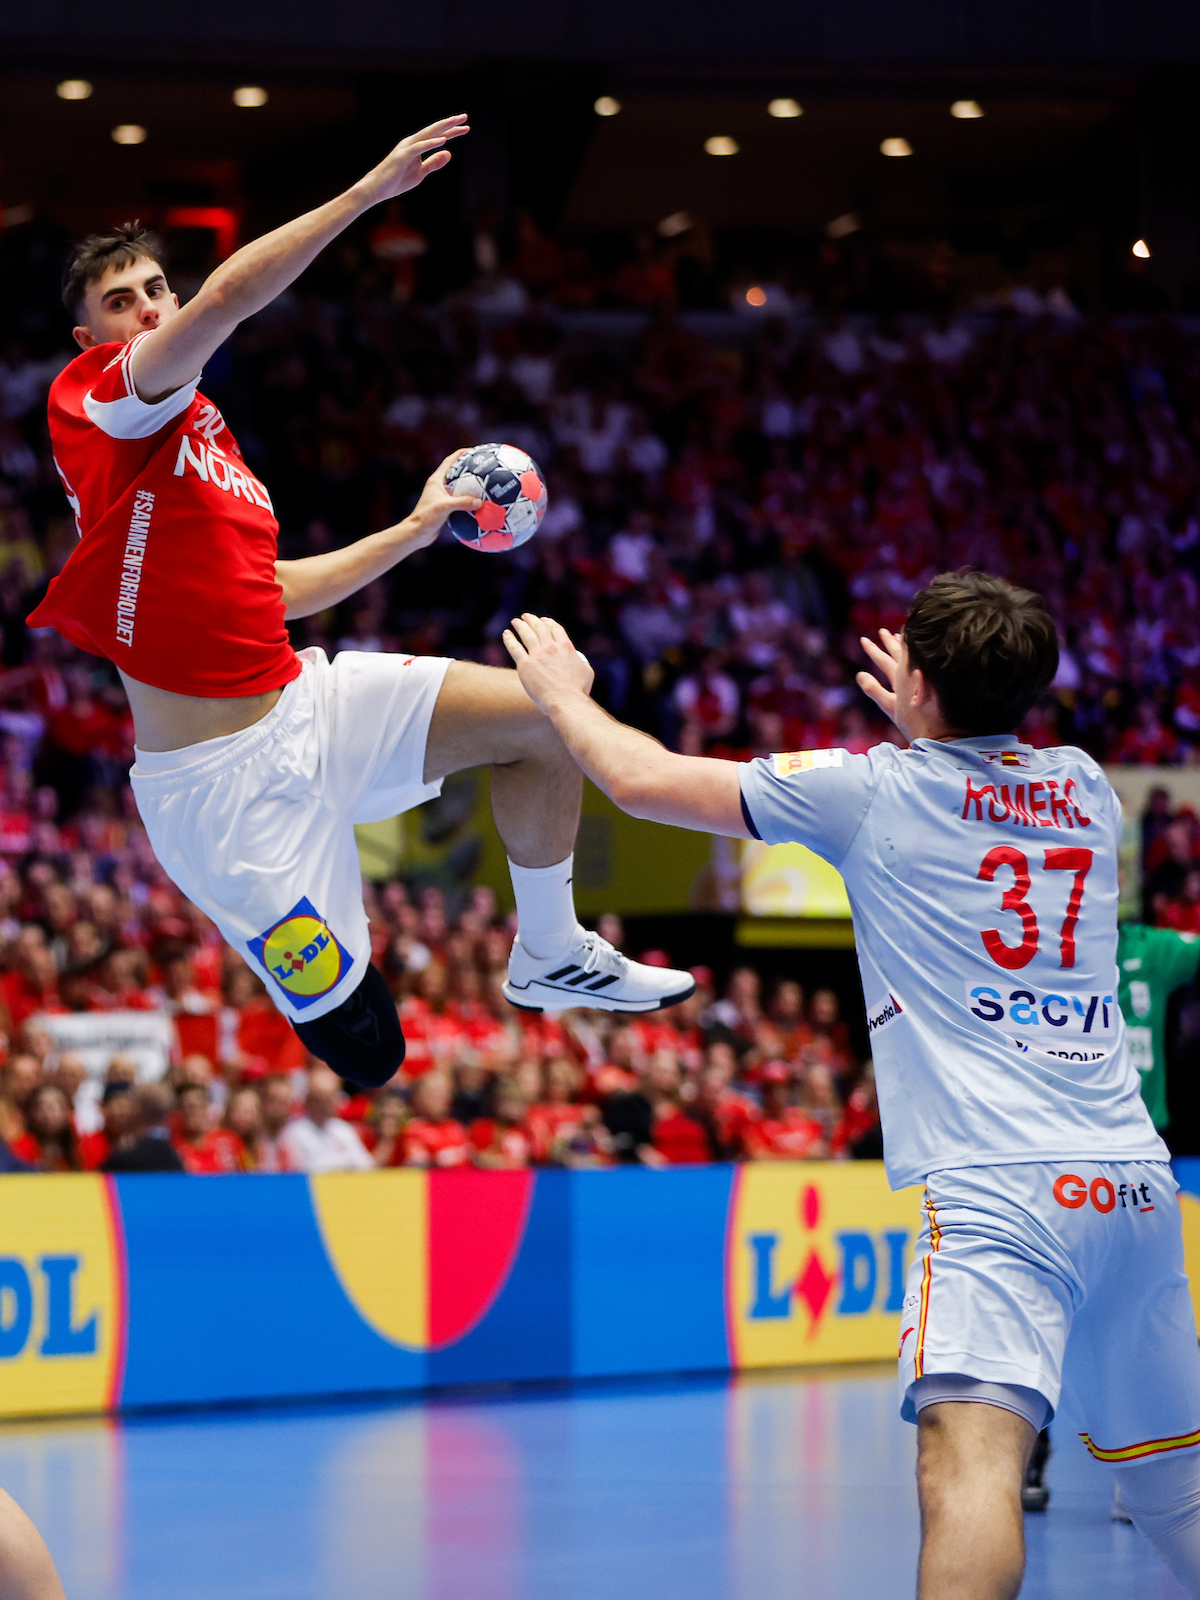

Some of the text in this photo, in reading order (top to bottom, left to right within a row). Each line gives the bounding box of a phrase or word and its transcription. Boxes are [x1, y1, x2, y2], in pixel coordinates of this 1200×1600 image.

[116, 489, 155, 648] #SAMMENFORHOLDET
[977, 846, 1093, 970] 37
[272, 932, 330, 980] LIDL
[970, 987, 1113, 1033] sacyr
